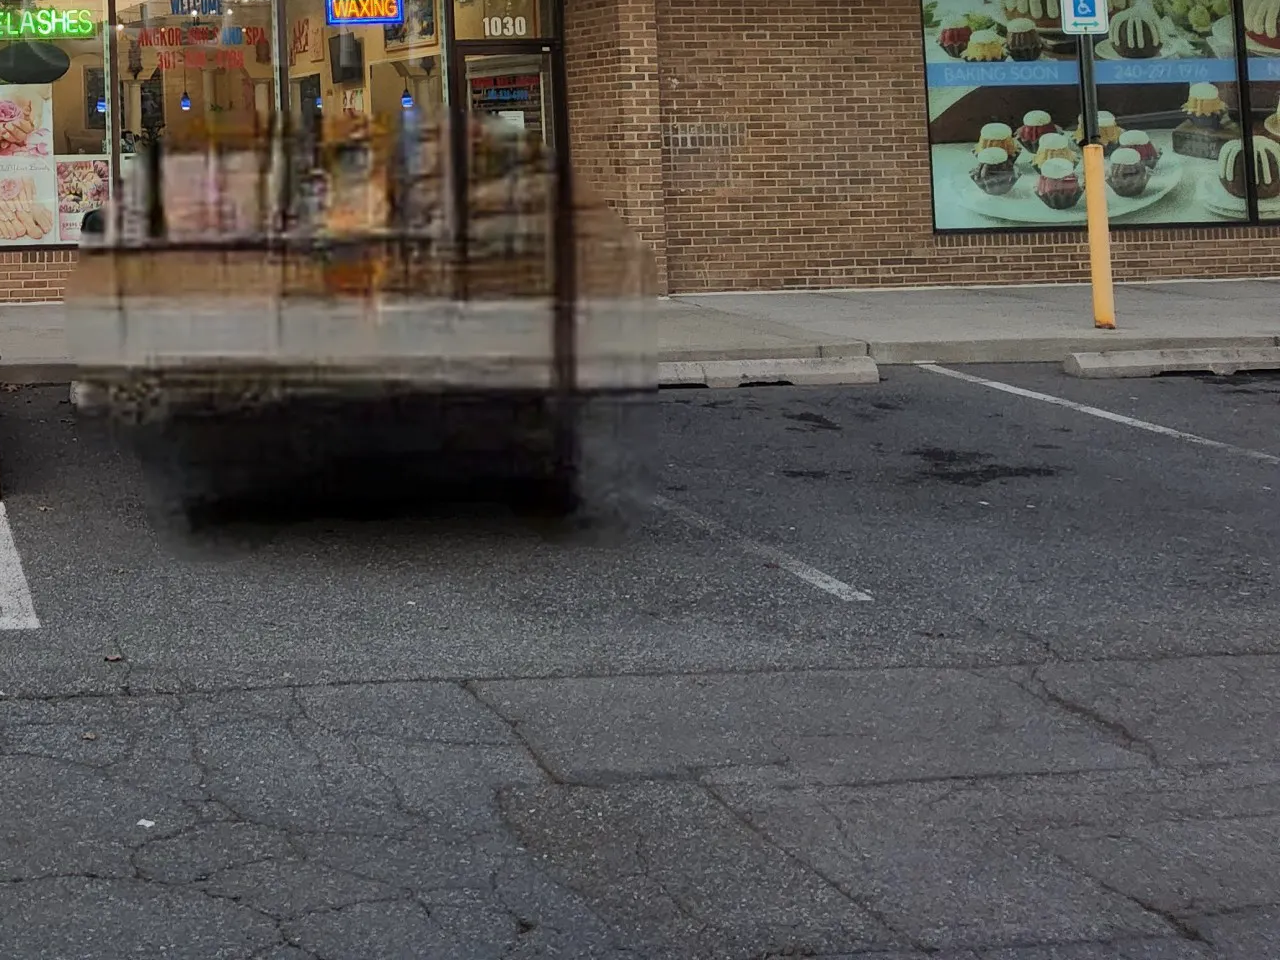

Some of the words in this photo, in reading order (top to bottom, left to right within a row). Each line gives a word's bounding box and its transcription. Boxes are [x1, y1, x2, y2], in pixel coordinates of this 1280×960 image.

[482, 16, 527, 37] 1030
[944, 66, 1007, 82] BAKING
[1010, 66, 1059, 81] SOON
